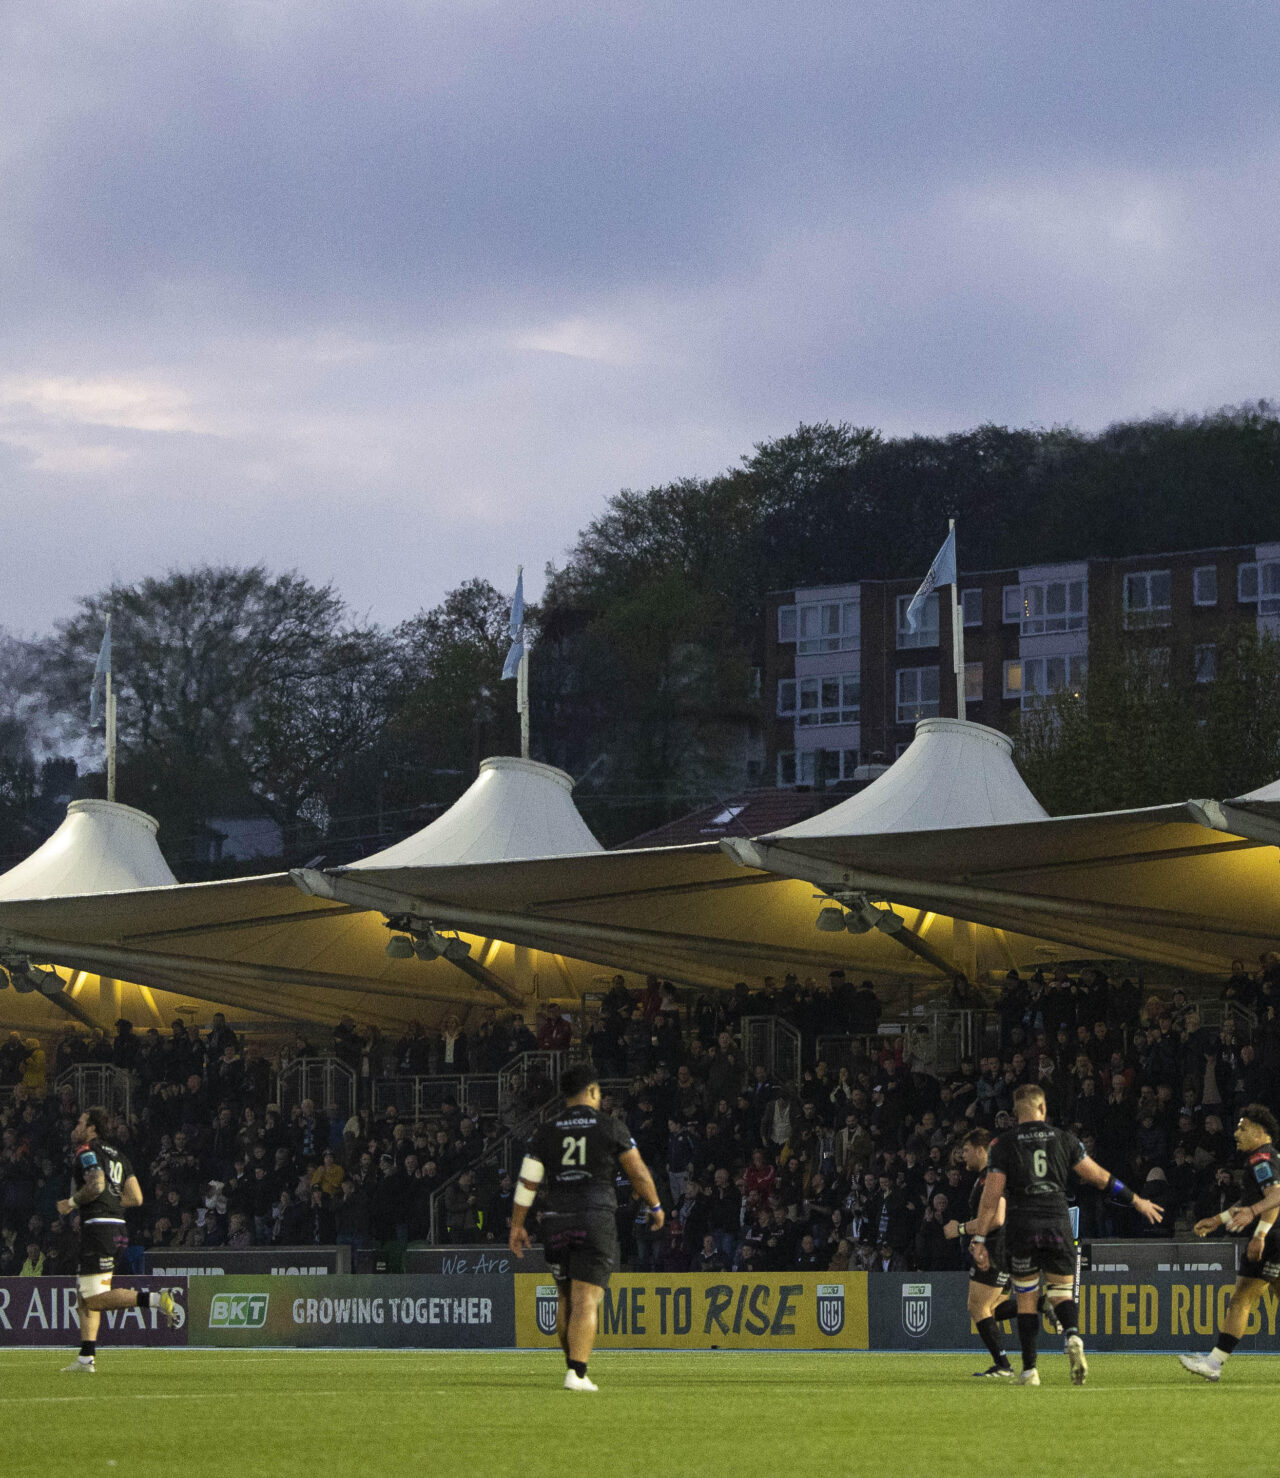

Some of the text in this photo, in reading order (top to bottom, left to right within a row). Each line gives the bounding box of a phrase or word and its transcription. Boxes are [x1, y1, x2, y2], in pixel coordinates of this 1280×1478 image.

[556, 1118, 597, 1128] MALCOLM
[1017, 1131, 1056, 1140] MALCOLM
[561, 1136, 587, 1166] 21
[1033, 1149, 1047, 1178] 6
[441, 1254, 511, 1275] We Are
[212, 1300, 265, 1321] BKT
[292, 1297, 493, 1325] GROWING TOGETHER
[597, 1284, 804, 1336] ME TO RISE
